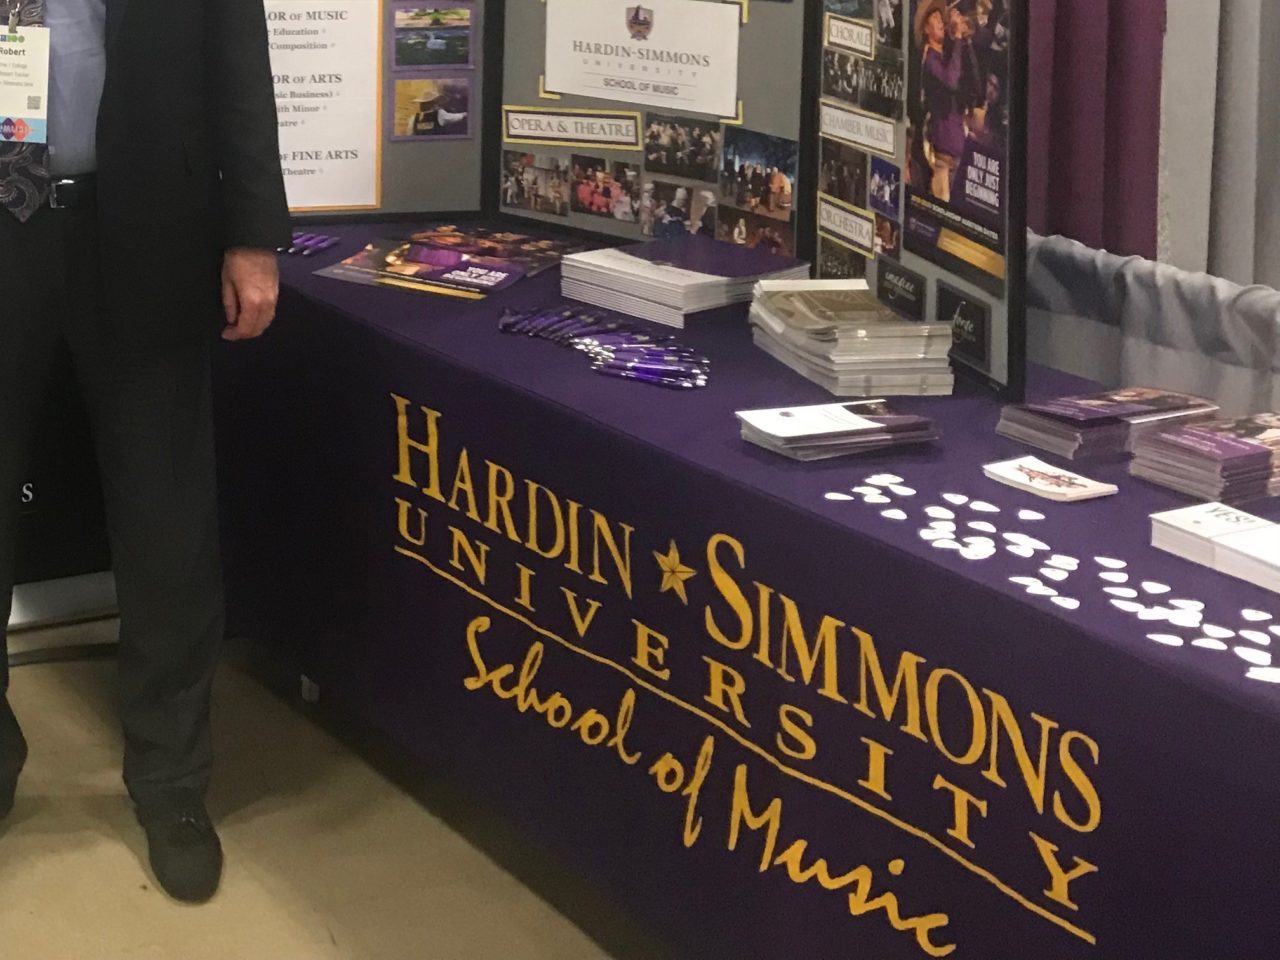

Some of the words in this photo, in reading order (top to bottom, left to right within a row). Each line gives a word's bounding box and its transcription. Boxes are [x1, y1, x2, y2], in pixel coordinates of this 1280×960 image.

[289, 12, 303, 21] OF
[306, 10, 349, 21] MUSIC
[273, 27, 319, 37] Education
[270, 41, 328, 52] Composition
[573, 40, 711, 68] HARDIN-SIMMONS
[309, 73, 343, 84] ARTS
[603, 77, 637, 91] SCHOOL
[639, 81, 651, 92] OF
[653, 84, 680, 96] MUSIC
[292, 104, 320, 113] Minor
[510, 117, 554, 133] OPERA
[557, 121, 569, 133] &
[573, 122, 635, 138] THEATRE
[291, 150, 323, 161] FINE
[324, 149, 359, 160] ARTS
[391, 394, 635, 599] HARDIN
[704, 533, 1102, 833] SIMMONS
[395, 497, 1098, 910] UNIVERSITY
[463, 616, 642, 764] School
[650, 735, 716, 848] of
[728, 764, 957, 957] Music
